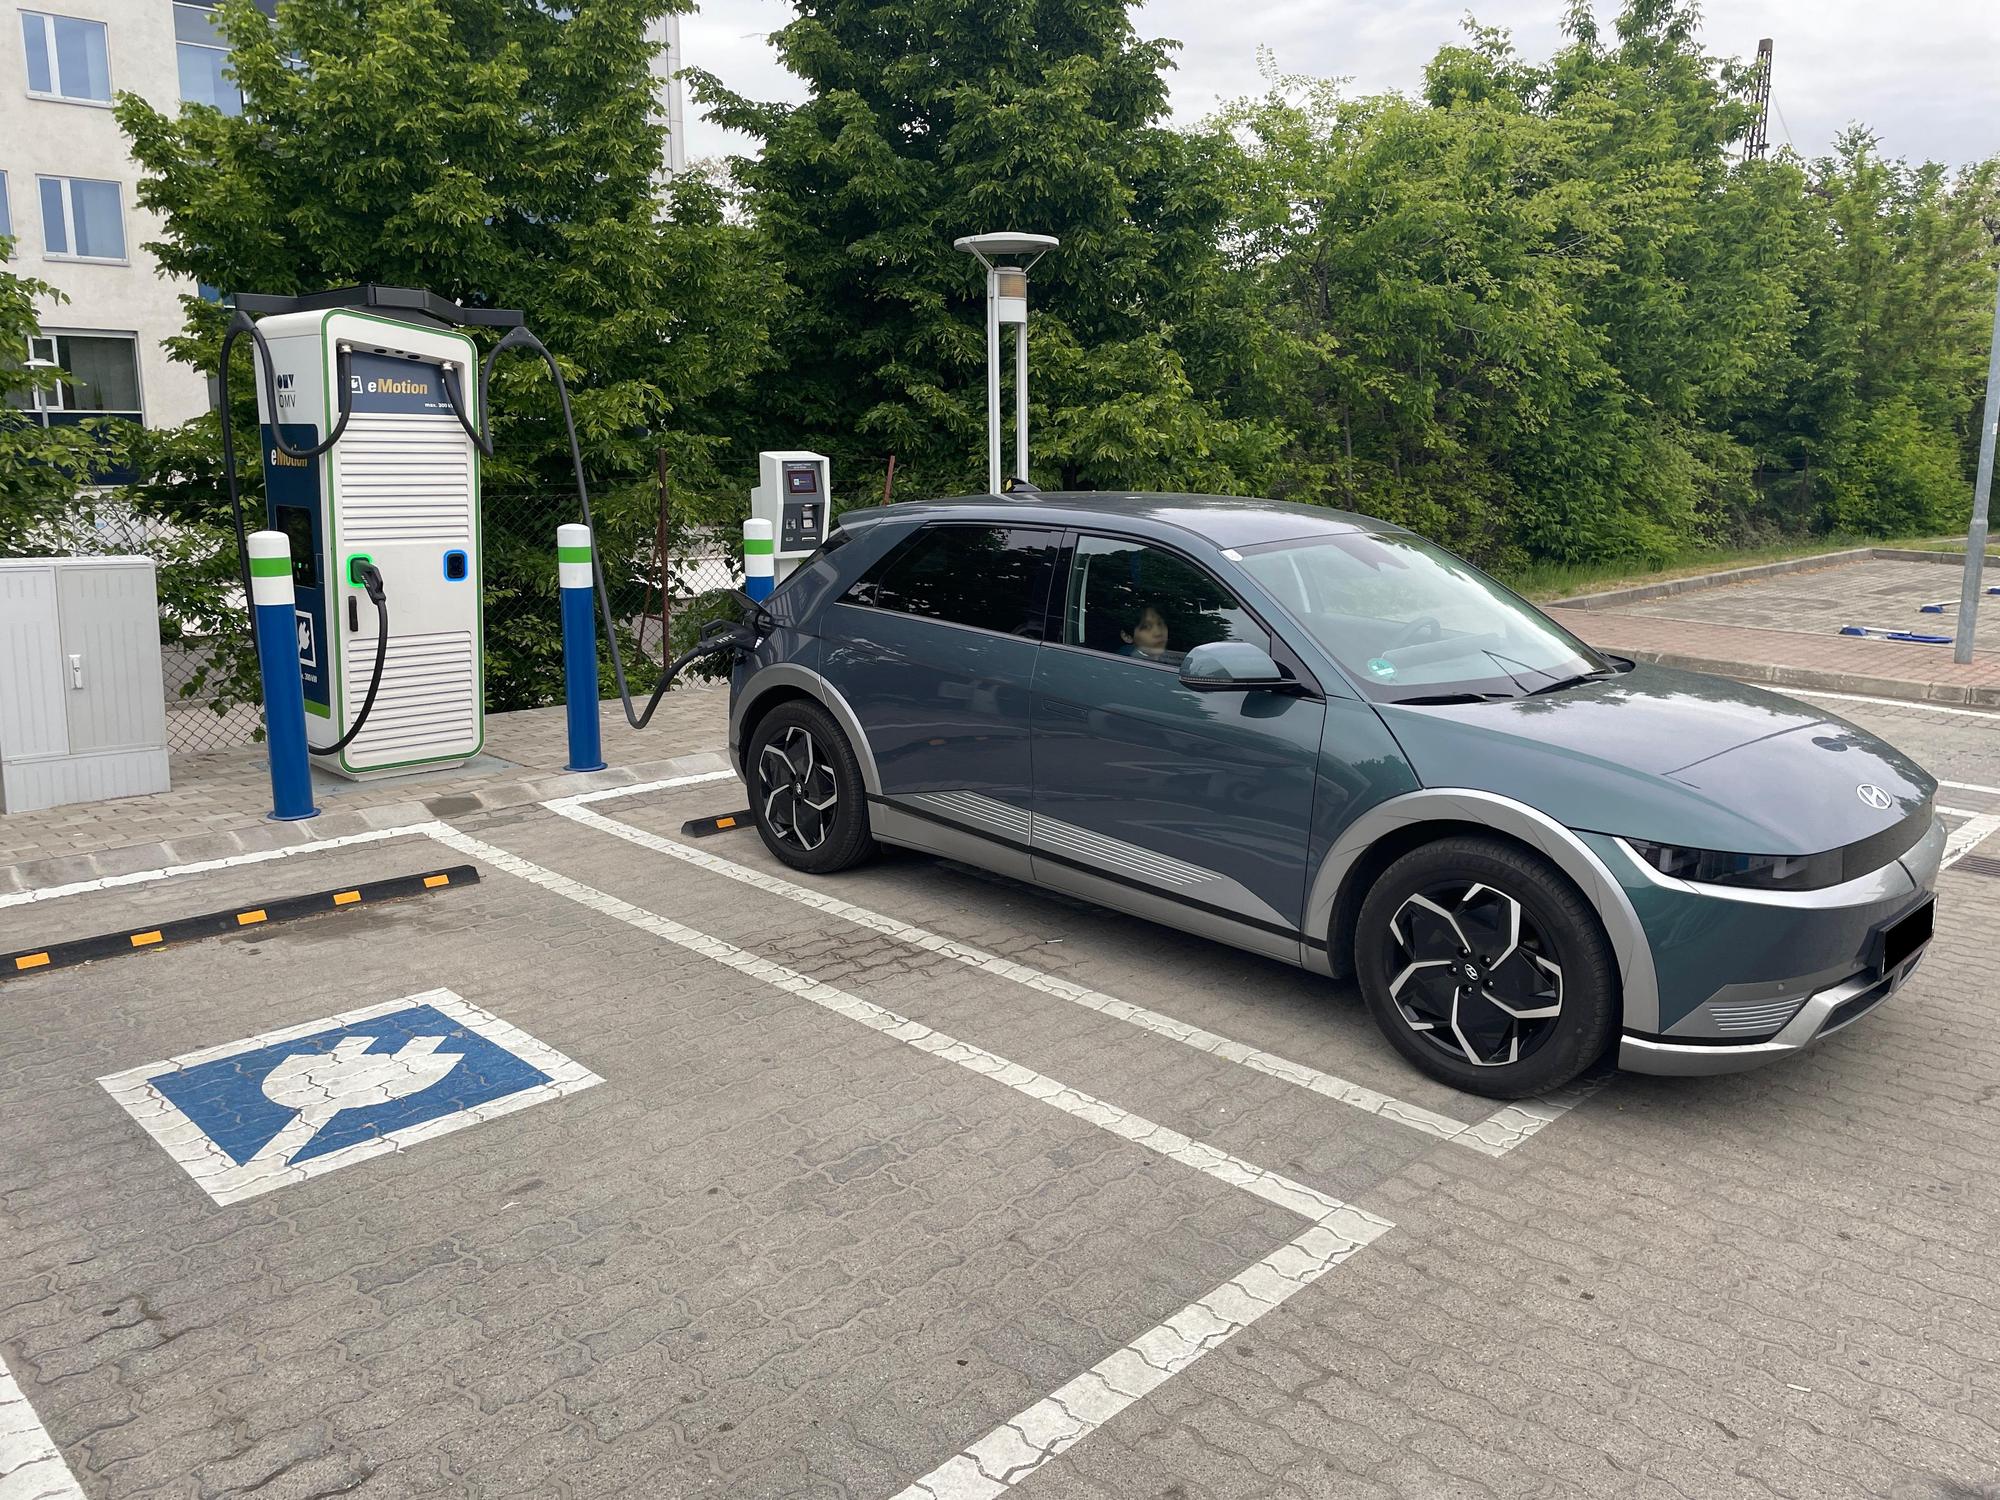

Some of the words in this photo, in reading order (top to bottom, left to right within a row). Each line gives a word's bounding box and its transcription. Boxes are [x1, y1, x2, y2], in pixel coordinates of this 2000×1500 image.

[278, 374, 294, 389] OMV
[367, 378, 428, 395] eMotion
[279, 394, 296, 408] OMV
